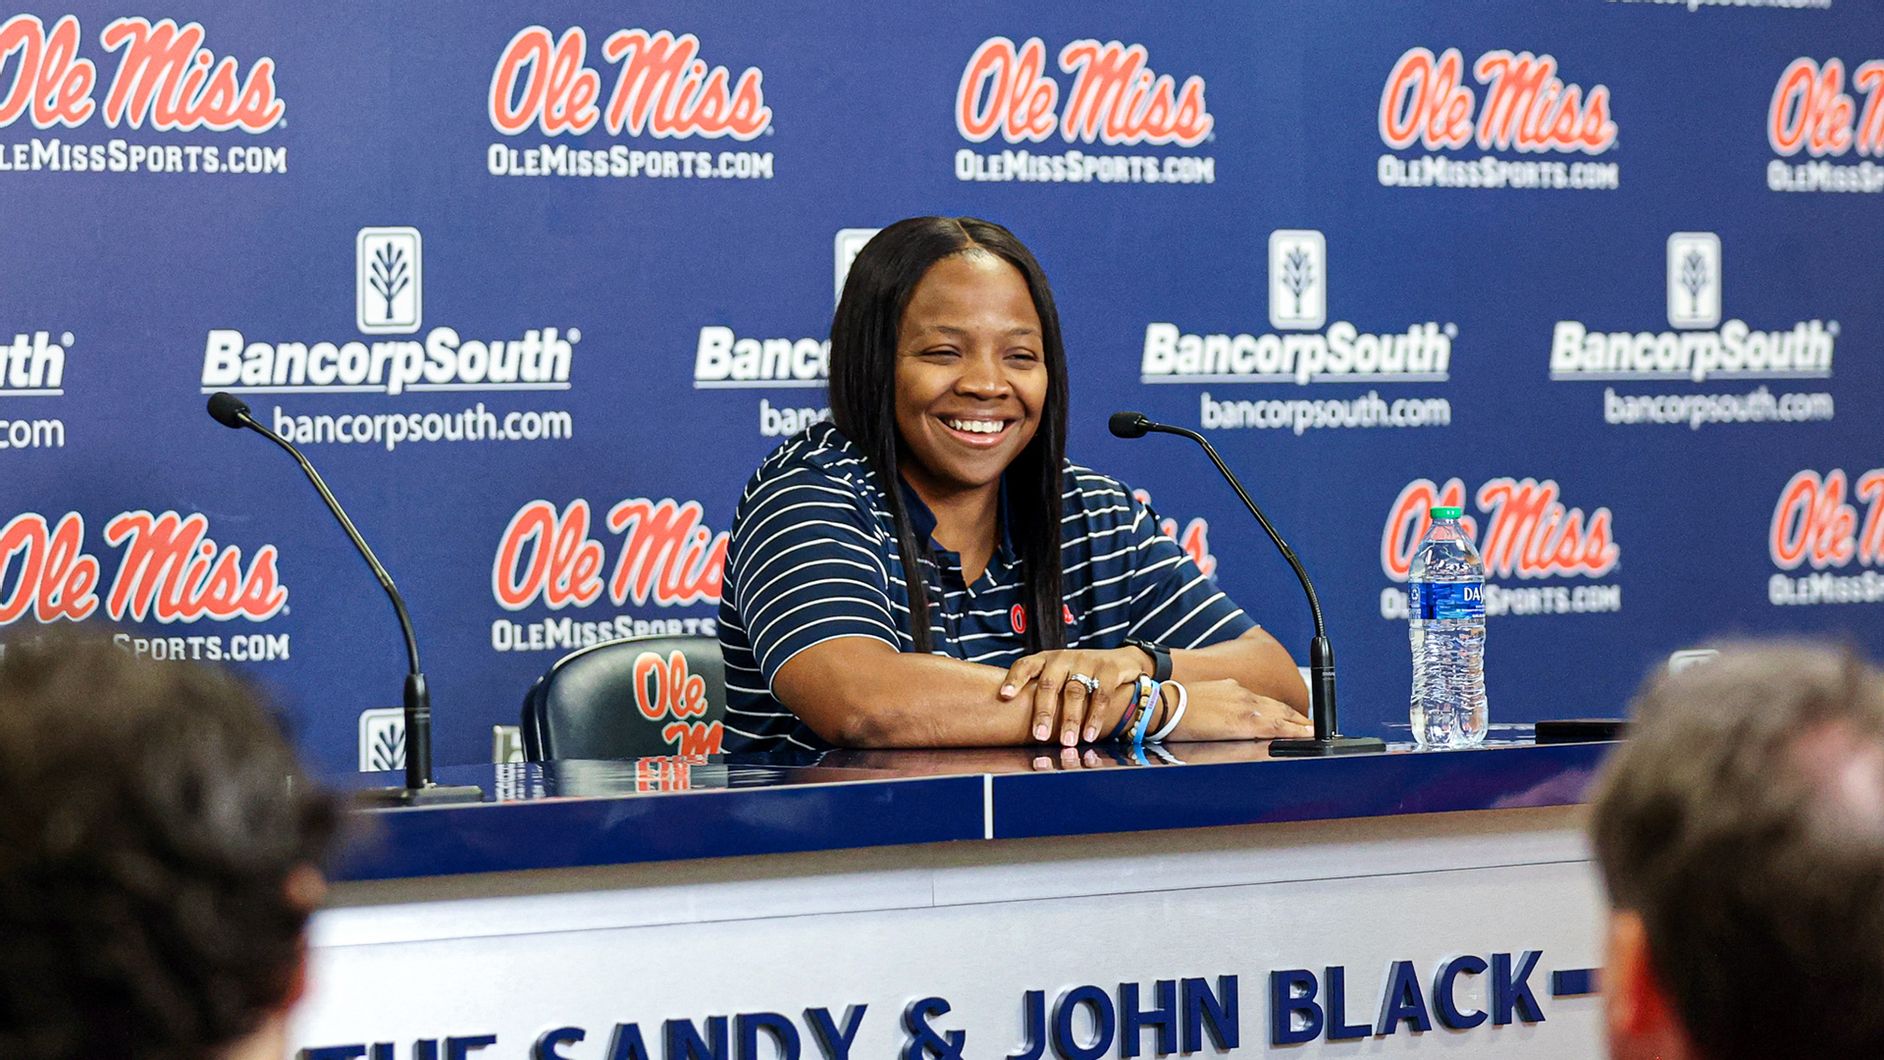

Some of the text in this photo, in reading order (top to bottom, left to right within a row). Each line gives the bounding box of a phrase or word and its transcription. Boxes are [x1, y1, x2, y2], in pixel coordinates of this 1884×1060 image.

[0, 14, 286, 134] Ole Miss
[488, 25, 773, 141] Ole Miss
[955, 36, 1214, 148] Ole Miss
[1378, 47, 1619, 155] Ole Miss
[1767, 56, 1856, 158] Ole
[202, 326, 573, 394] BancorpSouth
[1142, 321, 1451, 385] BancorpSouth
[1550, 319, 1834, 382] BancorpSouth
[273, 402, 573, 451] bancorpsouth.com
[1201, 390, 1451, 436] bancorpsouth.com
[1604, 385, 1835, 430] bancorpsouth.com
[0, 510, 289, 625] Ole Miss
[492, 498, 605, 611] Ole
[1476, 477, 1620, 579] Miss
[1769, 468, 1859, 571] Ole
[632, 650, 708, 720] Ole
[901, 997, 966, 1060] &
[1005, 975, 1240, 1060] JOHN
